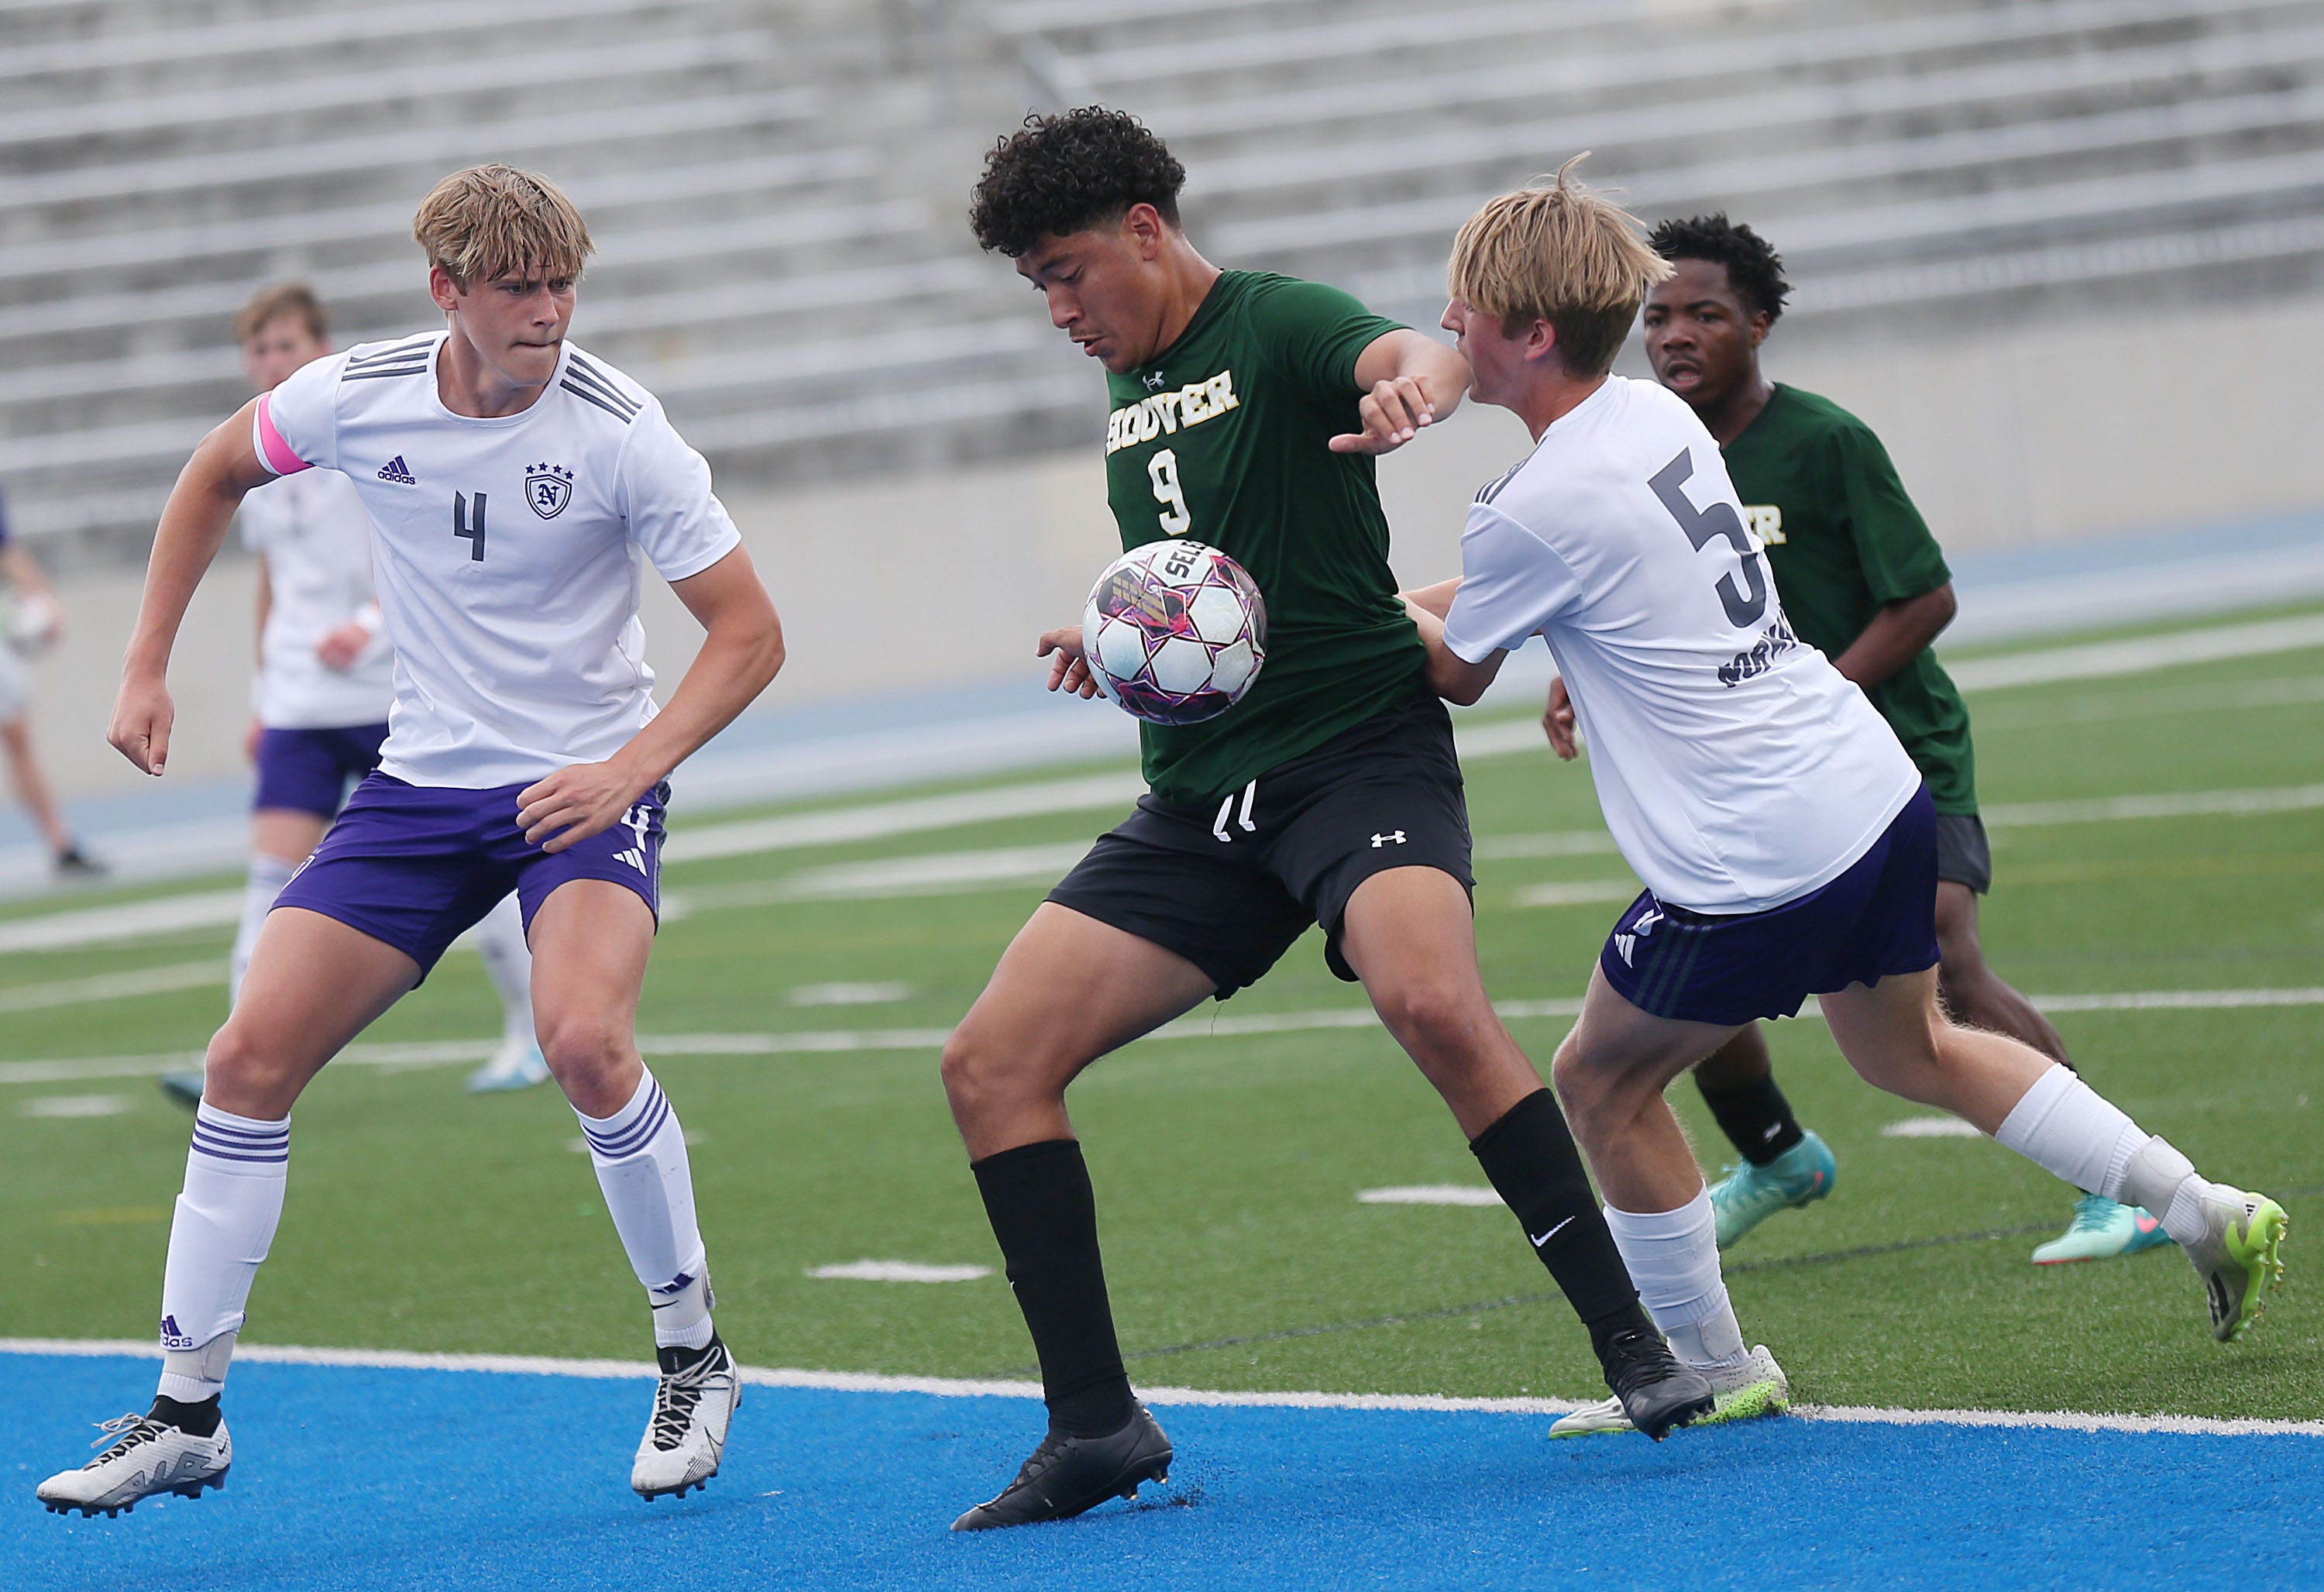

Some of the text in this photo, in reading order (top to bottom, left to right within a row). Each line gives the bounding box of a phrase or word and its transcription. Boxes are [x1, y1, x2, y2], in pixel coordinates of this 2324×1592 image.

[1105, 369, 1240, 458] HOOVER
[377, 470, 416, 485] adidas
[537, 483, 561, 507] N
[1147, 448, 1191, 536] 9
[453, 490, 487, 562] 4
[1646, 445, 1767, 629] 5
[162, 1333, 193, 1348] das
